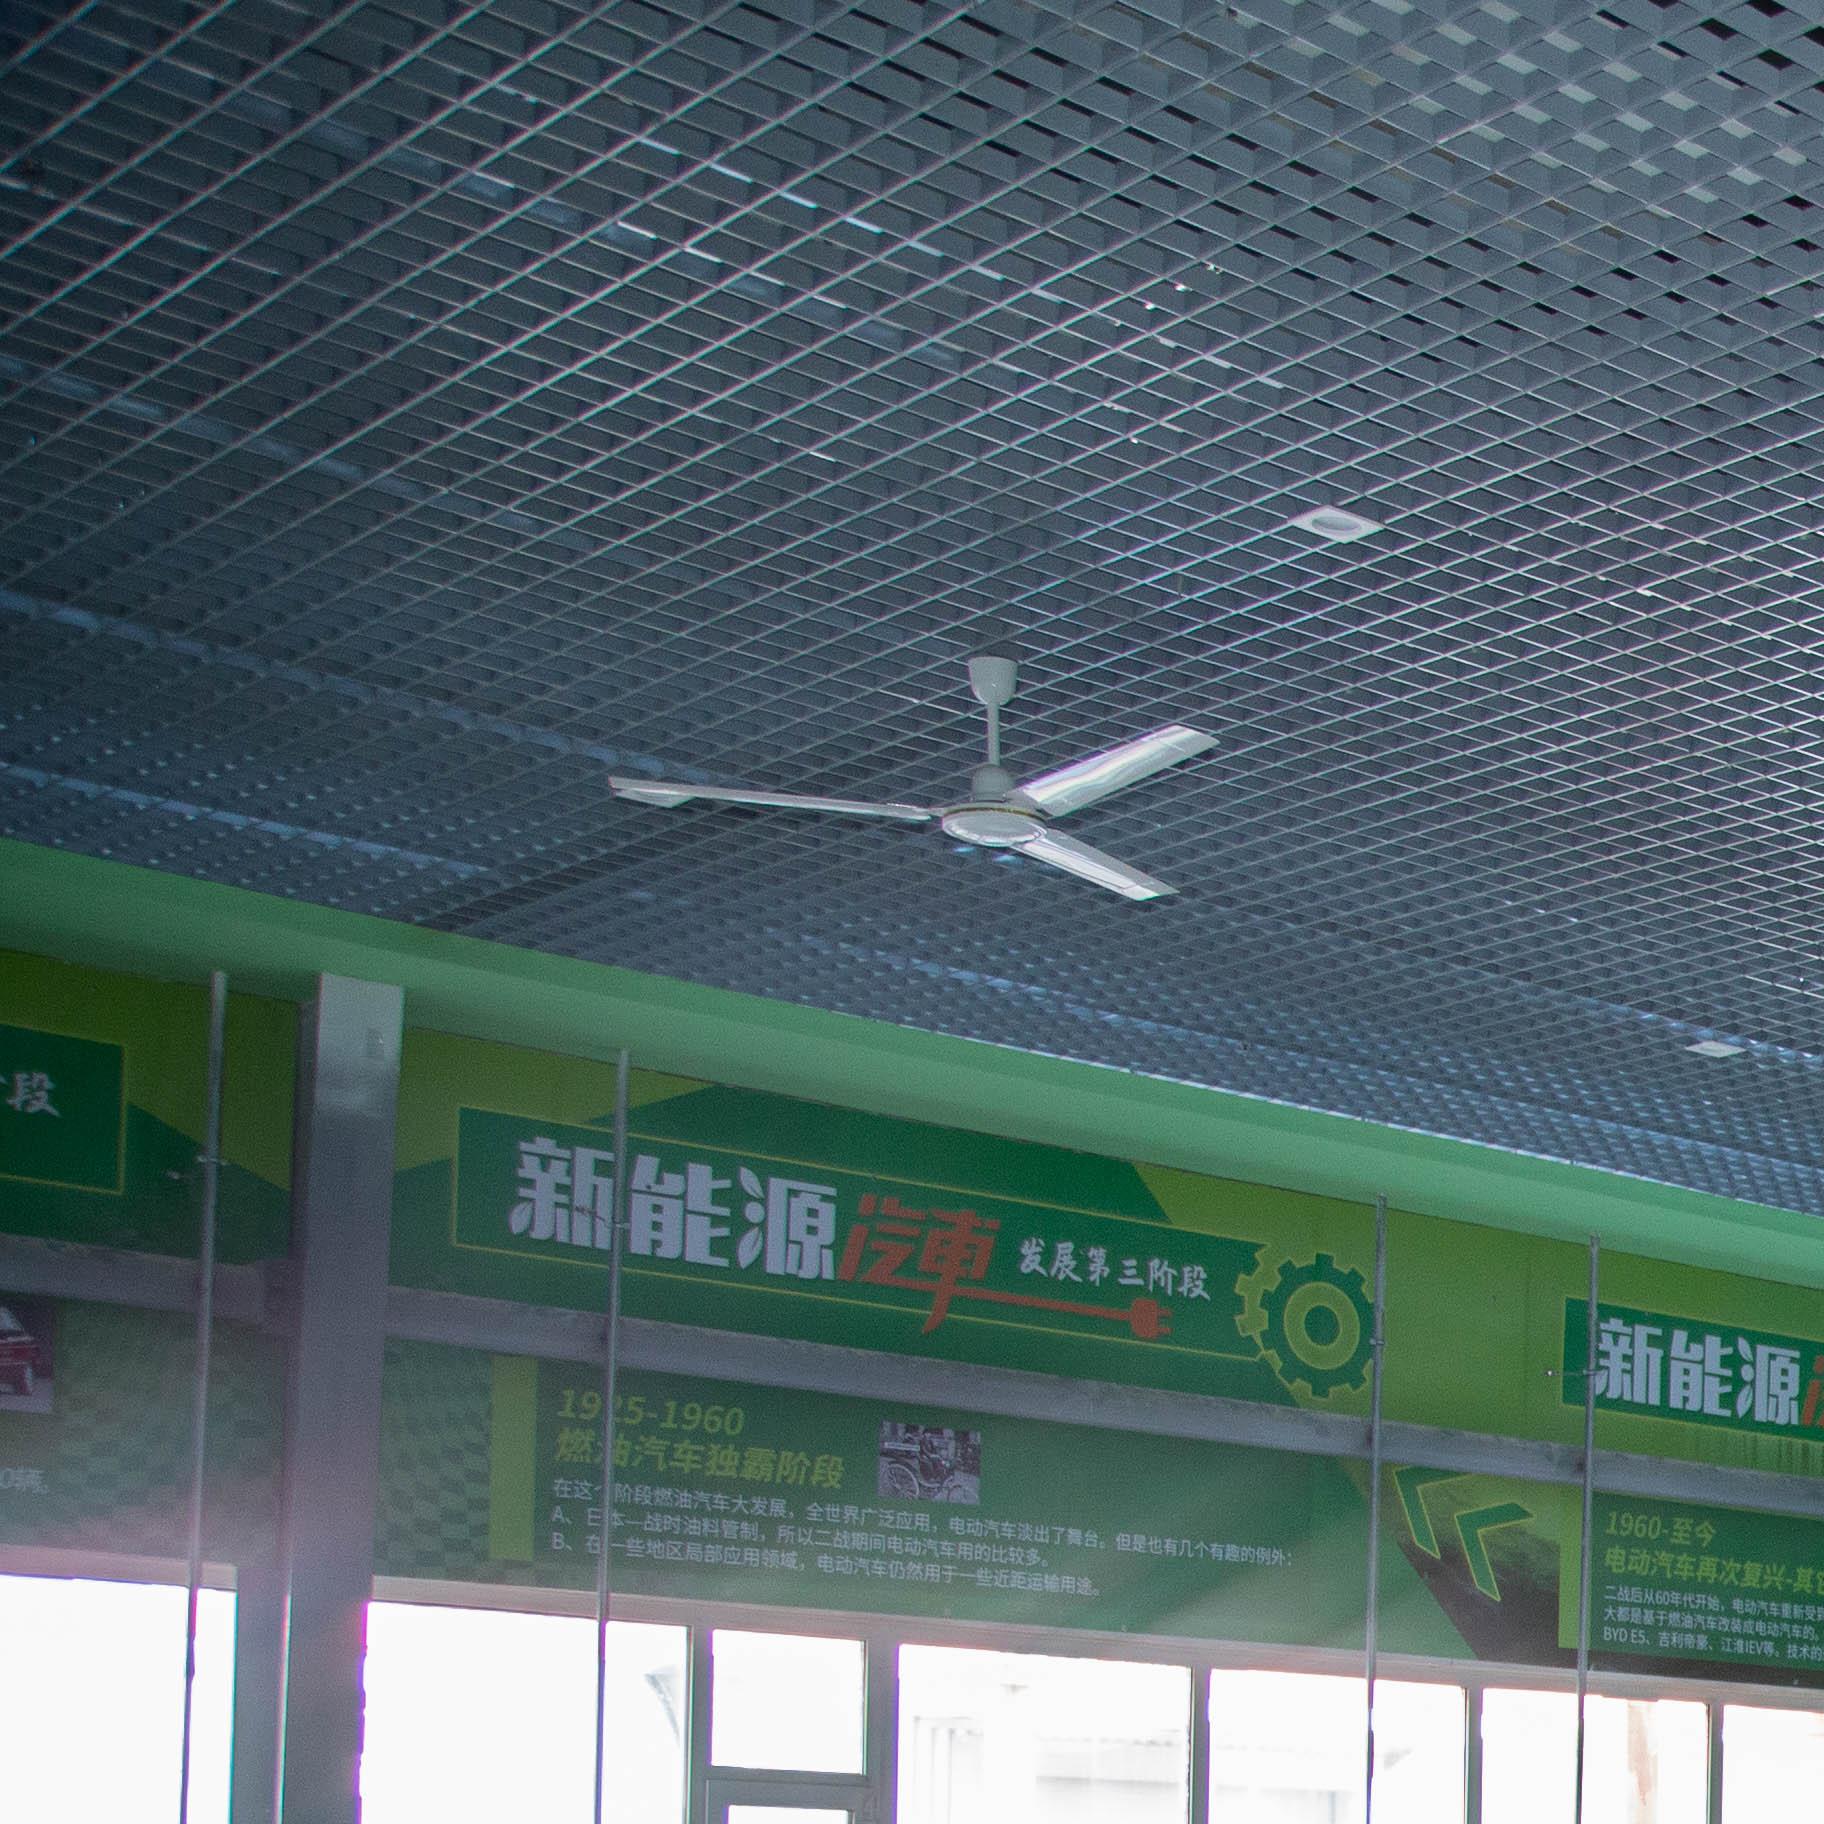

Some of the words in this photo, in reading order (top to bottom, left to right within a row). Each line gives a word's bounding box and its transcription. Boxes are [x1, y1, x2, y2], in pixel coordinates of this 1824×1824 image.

[1018, 1237, 1211, 1300] 发展第三阶段
[1605, 1510, 1716, 1547] 1960-至今
[1602, 1626, 1628, 1643] BYD
